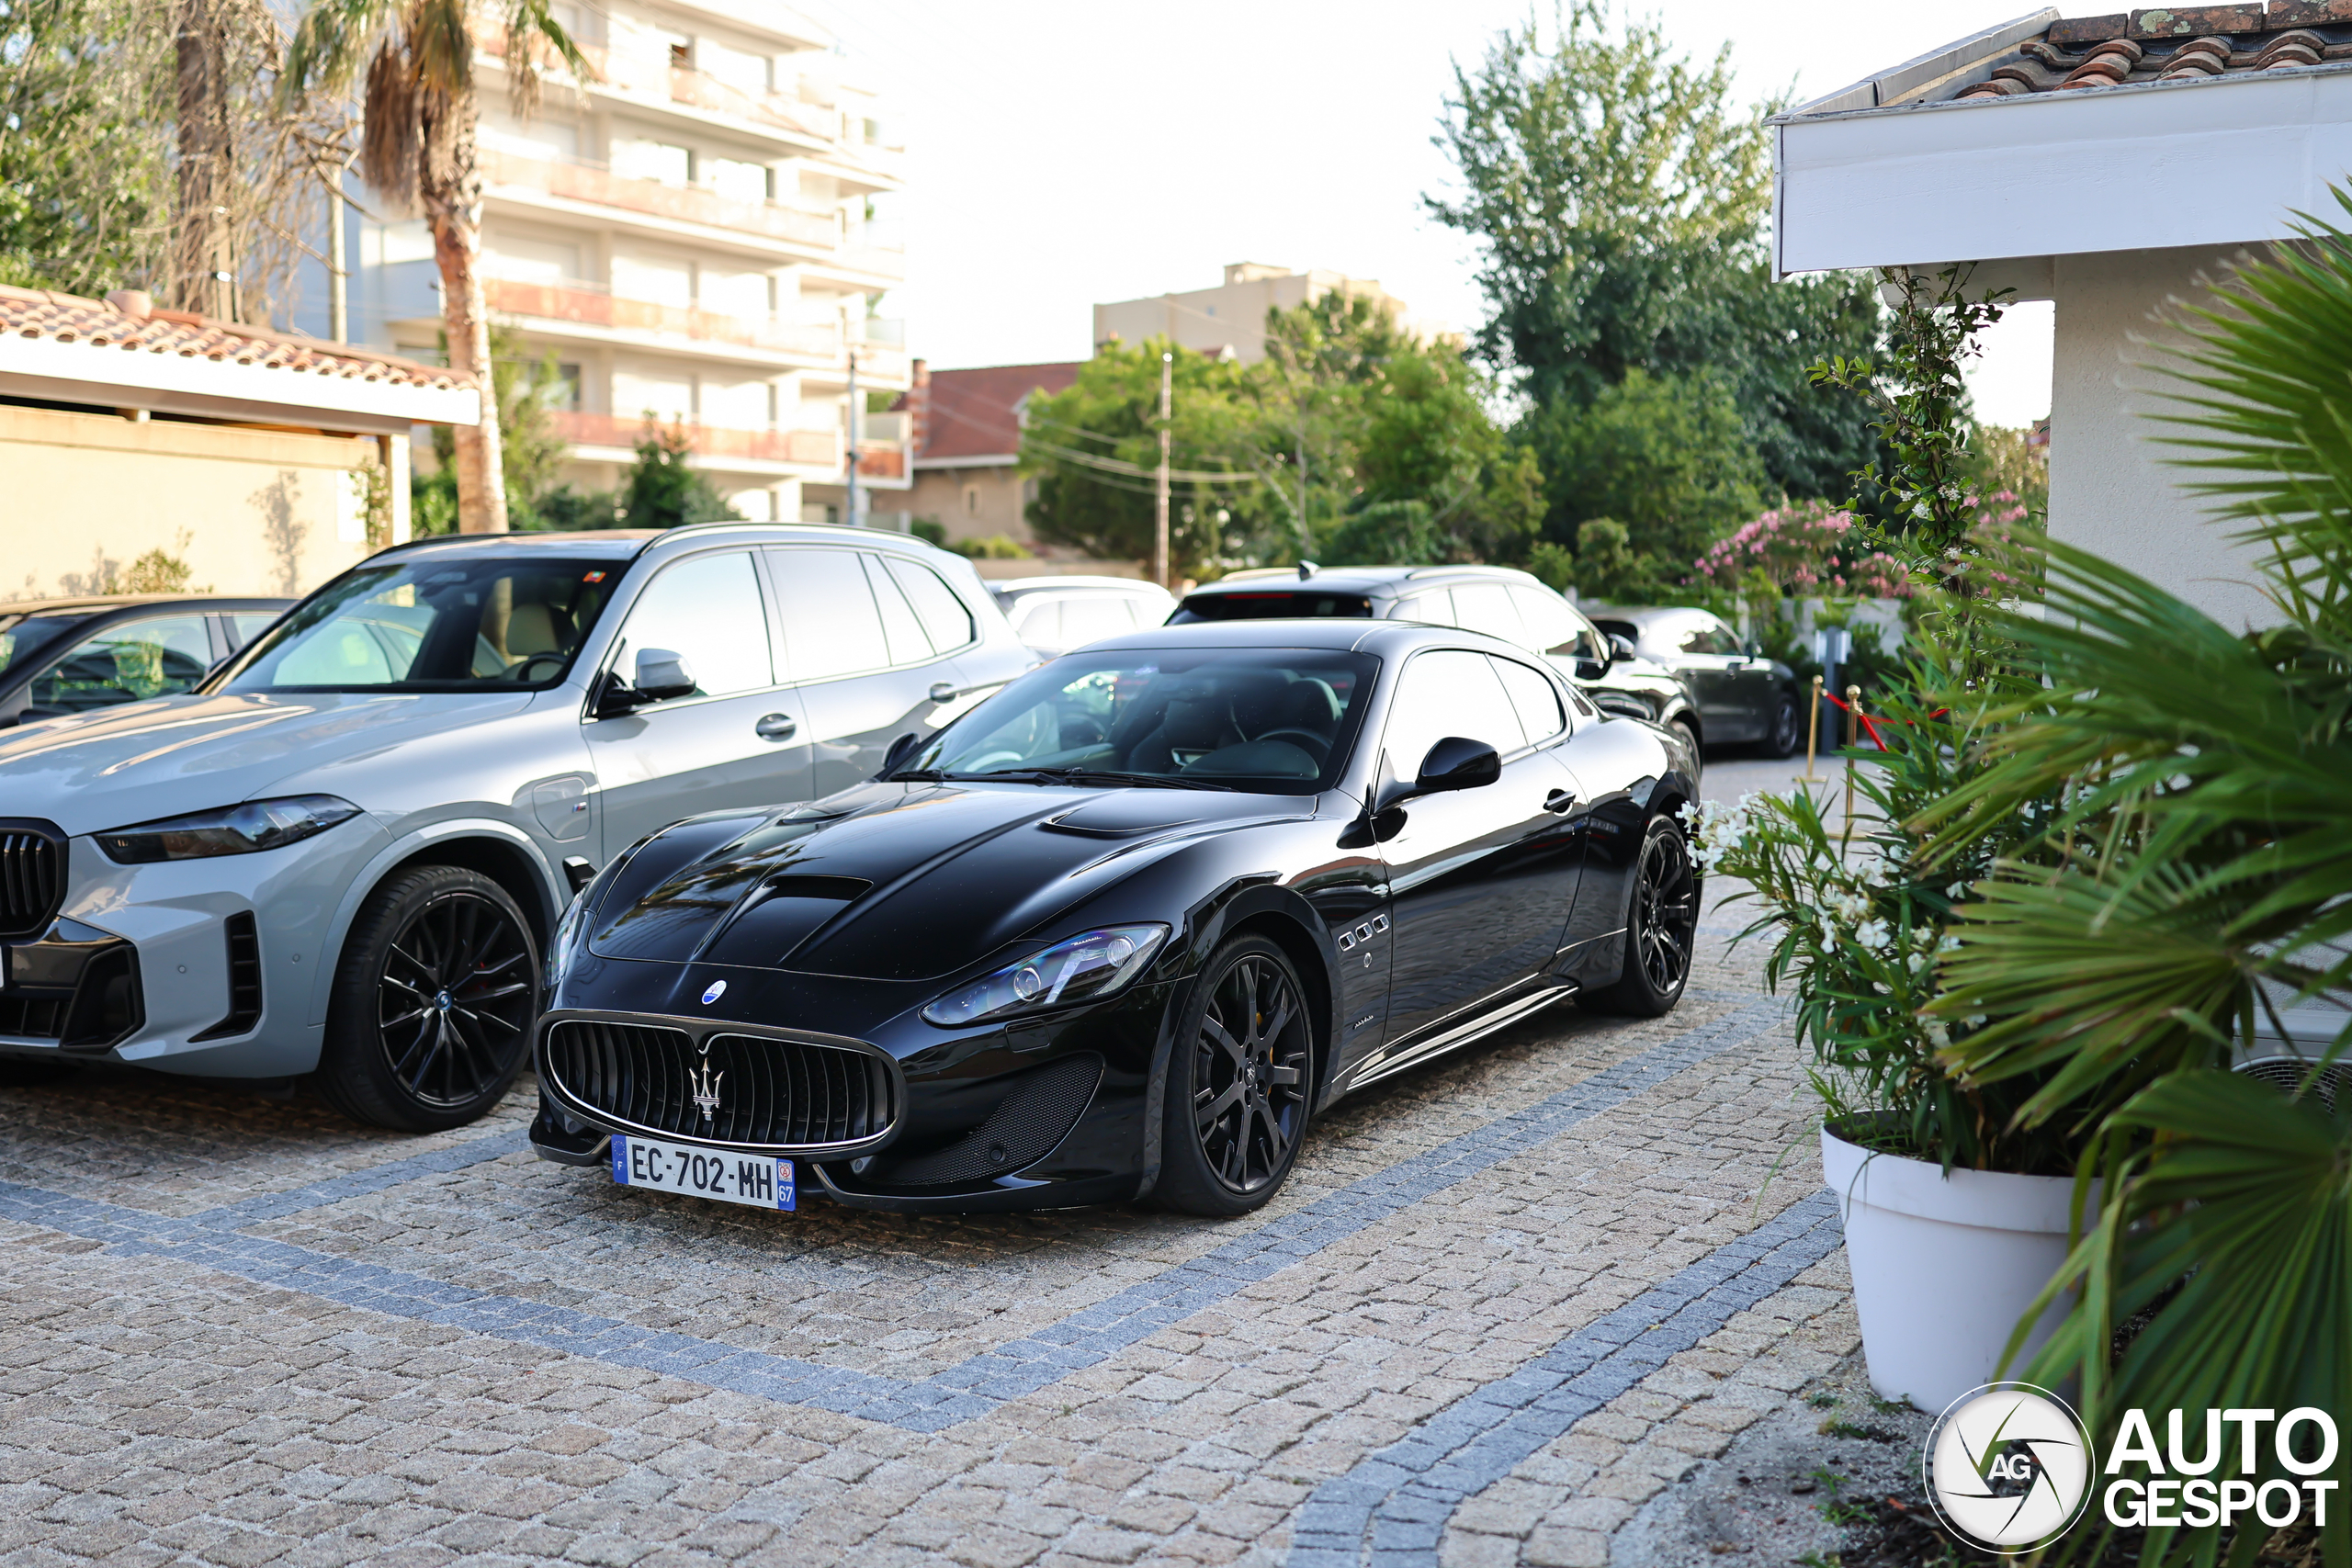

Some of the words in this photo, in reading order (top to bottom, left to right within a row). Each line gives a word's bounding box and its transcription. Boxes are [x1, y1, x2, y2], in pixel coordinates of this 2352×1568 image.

[617, 1160, 623, 1170] F
[631, 1144, 773, 1201] EC-702-MH
[778, 1185, 793, 1202] 67
